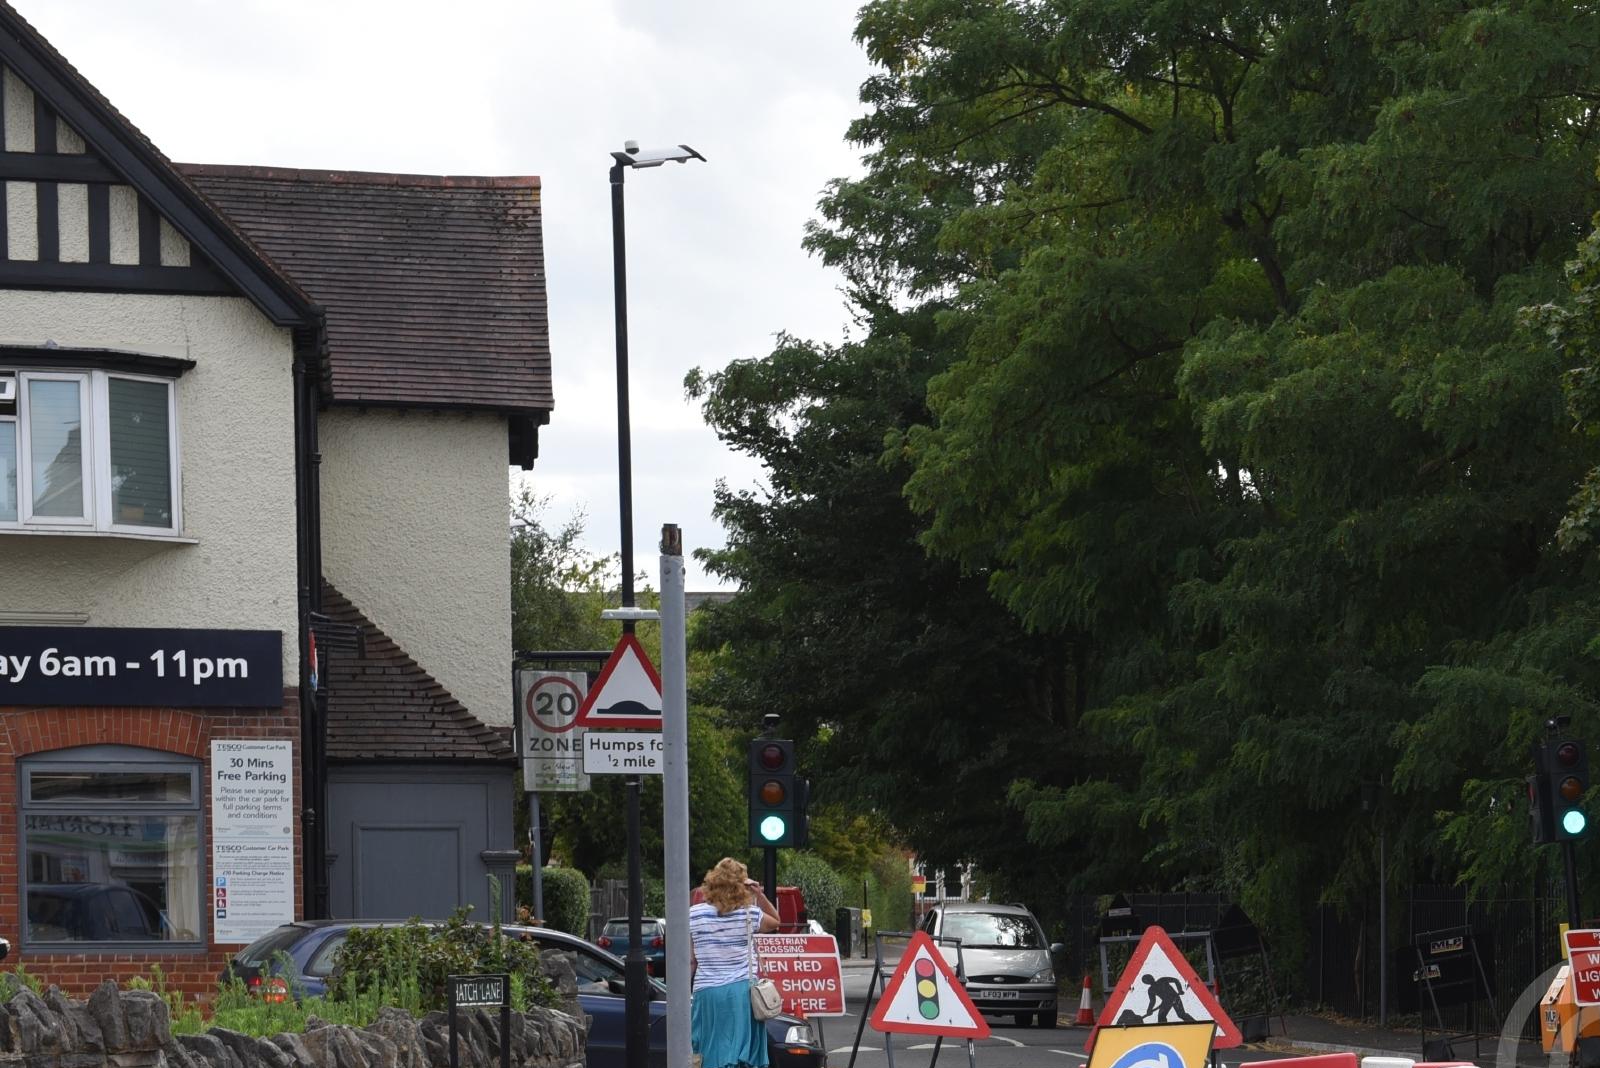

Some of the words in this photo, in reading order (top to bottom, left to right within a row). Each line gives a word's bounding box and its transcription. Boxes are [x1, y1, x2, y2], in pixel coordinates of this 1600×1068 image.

[39, 648, 116, 677] 6am
[150, 649, 248, 685] 11pm
[536, 692, 576, 716] 20
[530, 737, 582, 752] ZONE
[590, 738, 644, 752] Humps
[650, 739, 663, 751] fo
[230, 758, 244, 768] 30
[247, 758, 274, 768] Mins
[623, 755, 656, 768] mile
[217, 770, 241, 781] Free
[245, 770, 287, 784] Parking
[220, 786, 242, 794] Please
[258, 786, 285, 795] signage
[263, 796, 279, 804] park
[223, 803, 234, 811] full
[235, 803, 261, 812] parking
[757, 945, 806, 954] CROSSING
[758, 960, 789, 973] HEN
[793, 960, 822, 973] RED
[782, 978, 836, 992] SHOWS
[791, 999, 827, 1011] HERE
